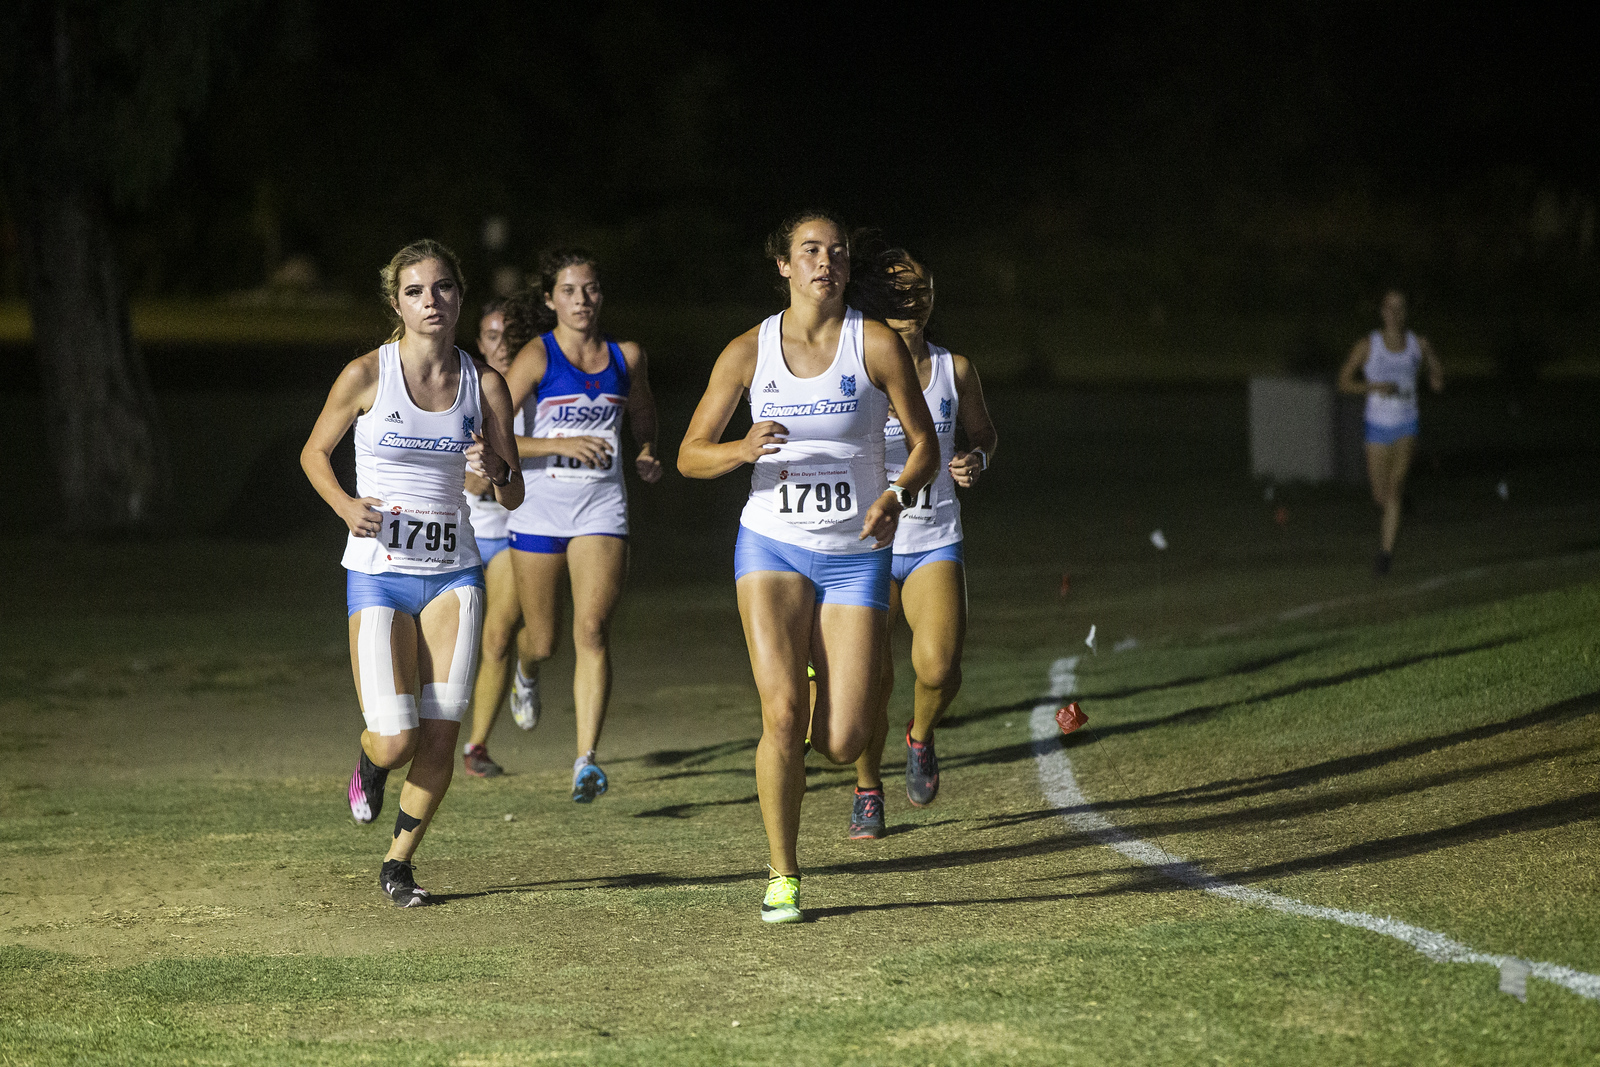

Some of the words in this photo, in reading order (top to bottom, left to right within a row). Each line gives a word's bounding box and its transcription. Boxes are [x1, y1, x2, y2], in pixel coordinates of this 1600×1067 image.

[761, 403, 813, 417] SONOMA
[813, 400, 857, 415] STATE
[379, 433, 436, 450] SONOMA
[779, 481, 852, 514] 1798
[388, 519, 457, 553] 1795
